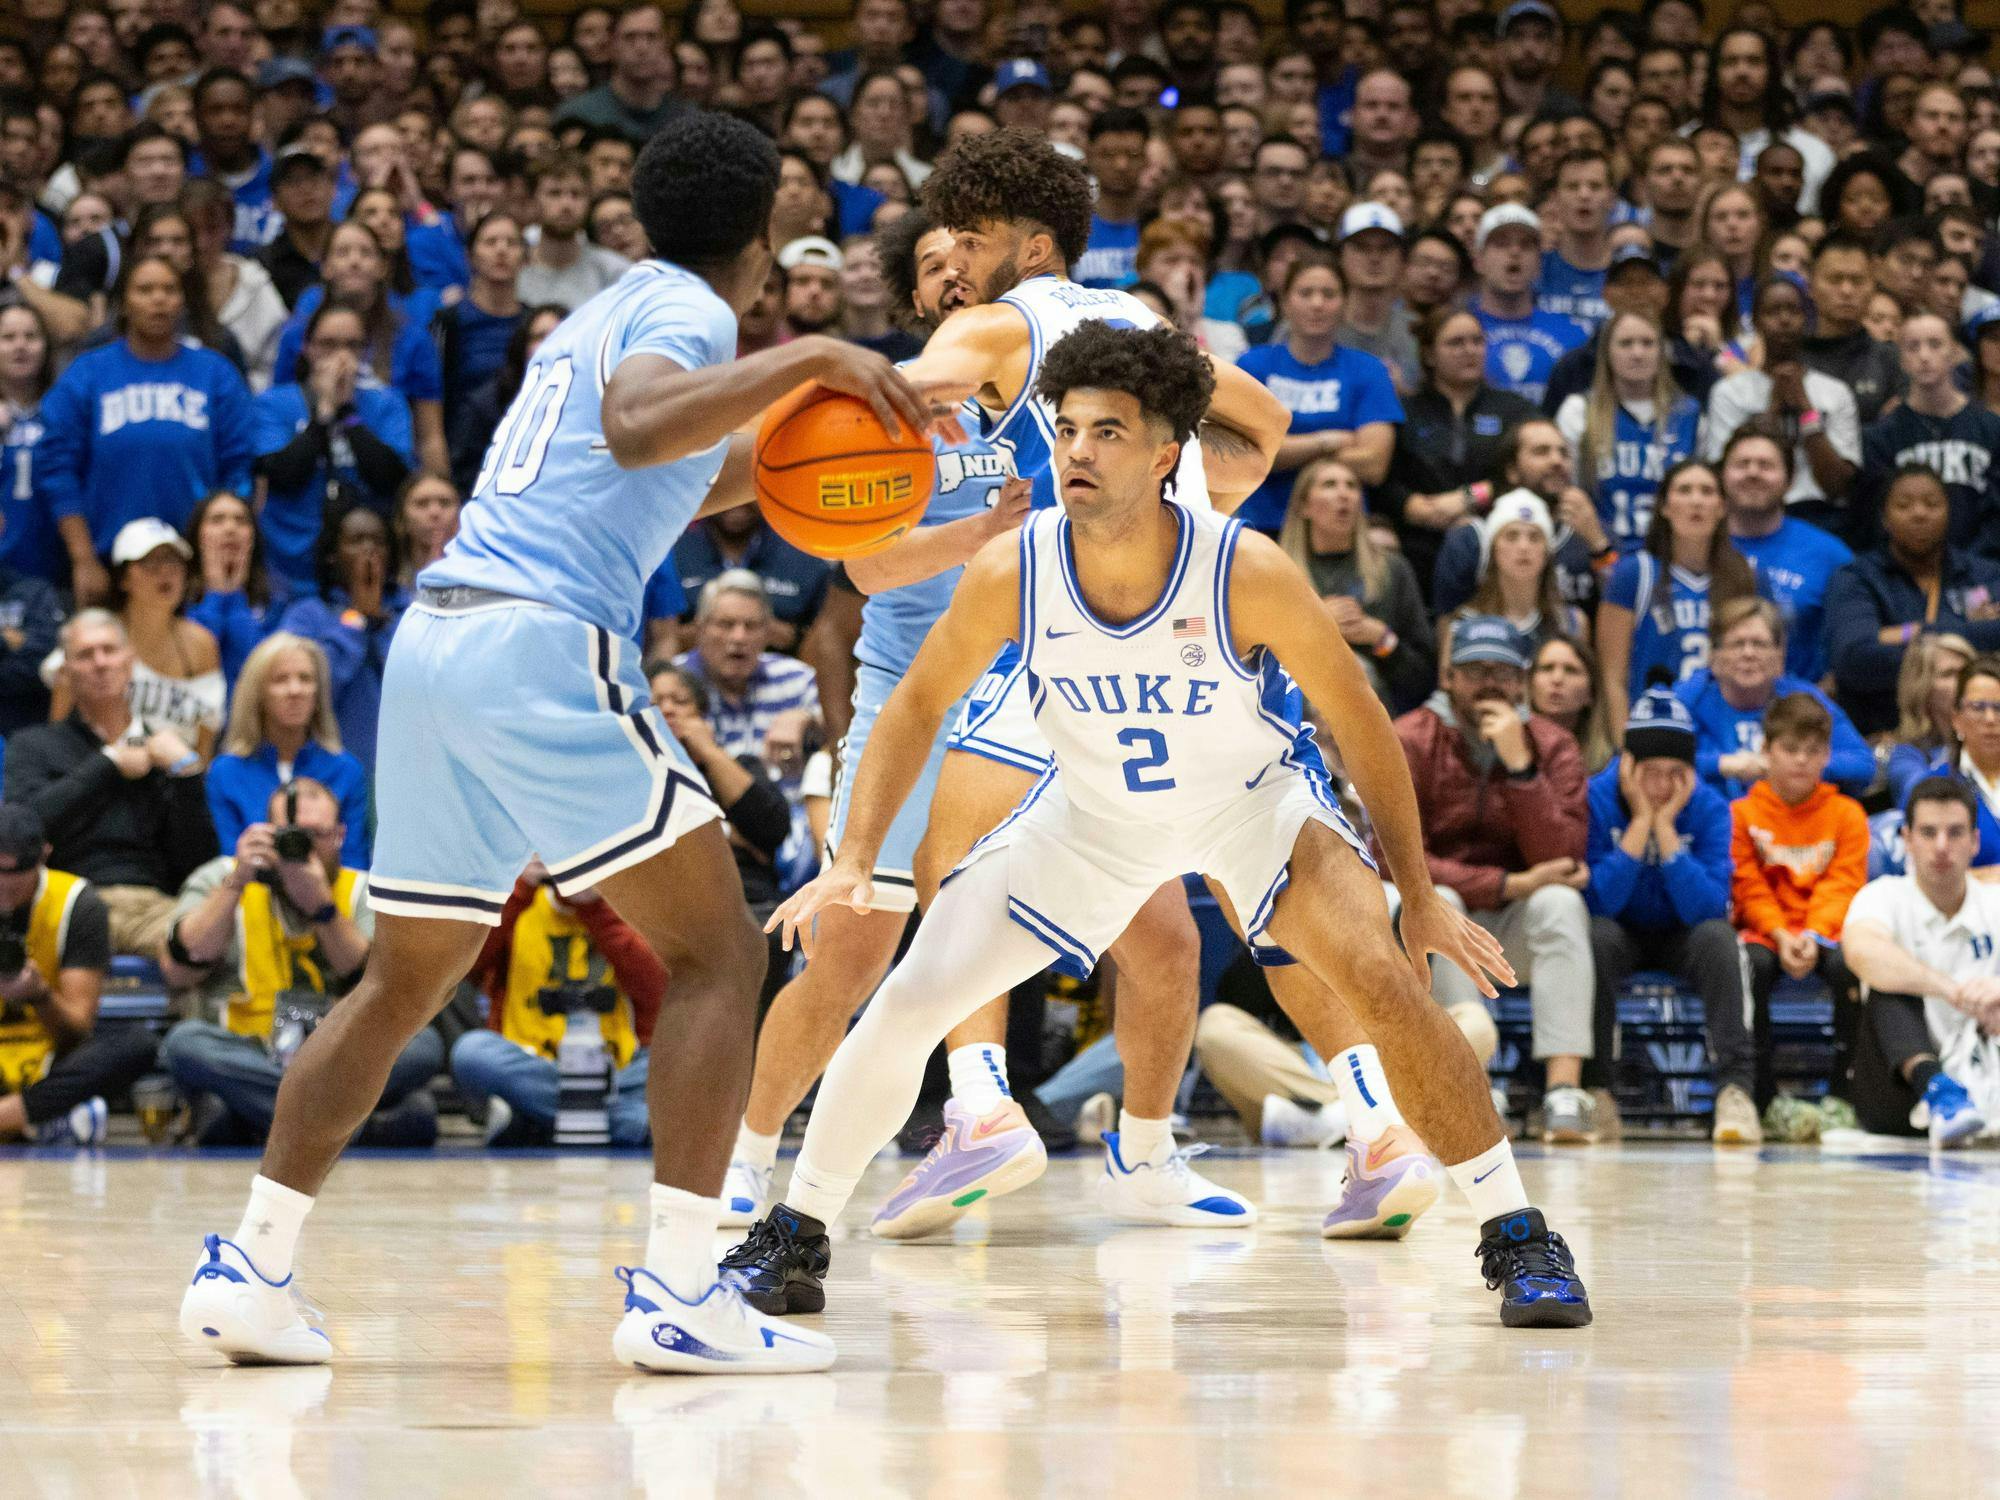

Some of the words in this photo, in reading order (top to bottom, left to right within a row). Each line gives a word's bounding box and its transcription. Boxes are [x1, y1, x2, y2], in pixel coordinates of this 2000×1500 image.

[99, 382, 209, 436] DUKE
[820, 474, 912, 509] ELITE
[1050, 673, 1219, 716] DUKE
[1116, 727, 1176, 792] 2
